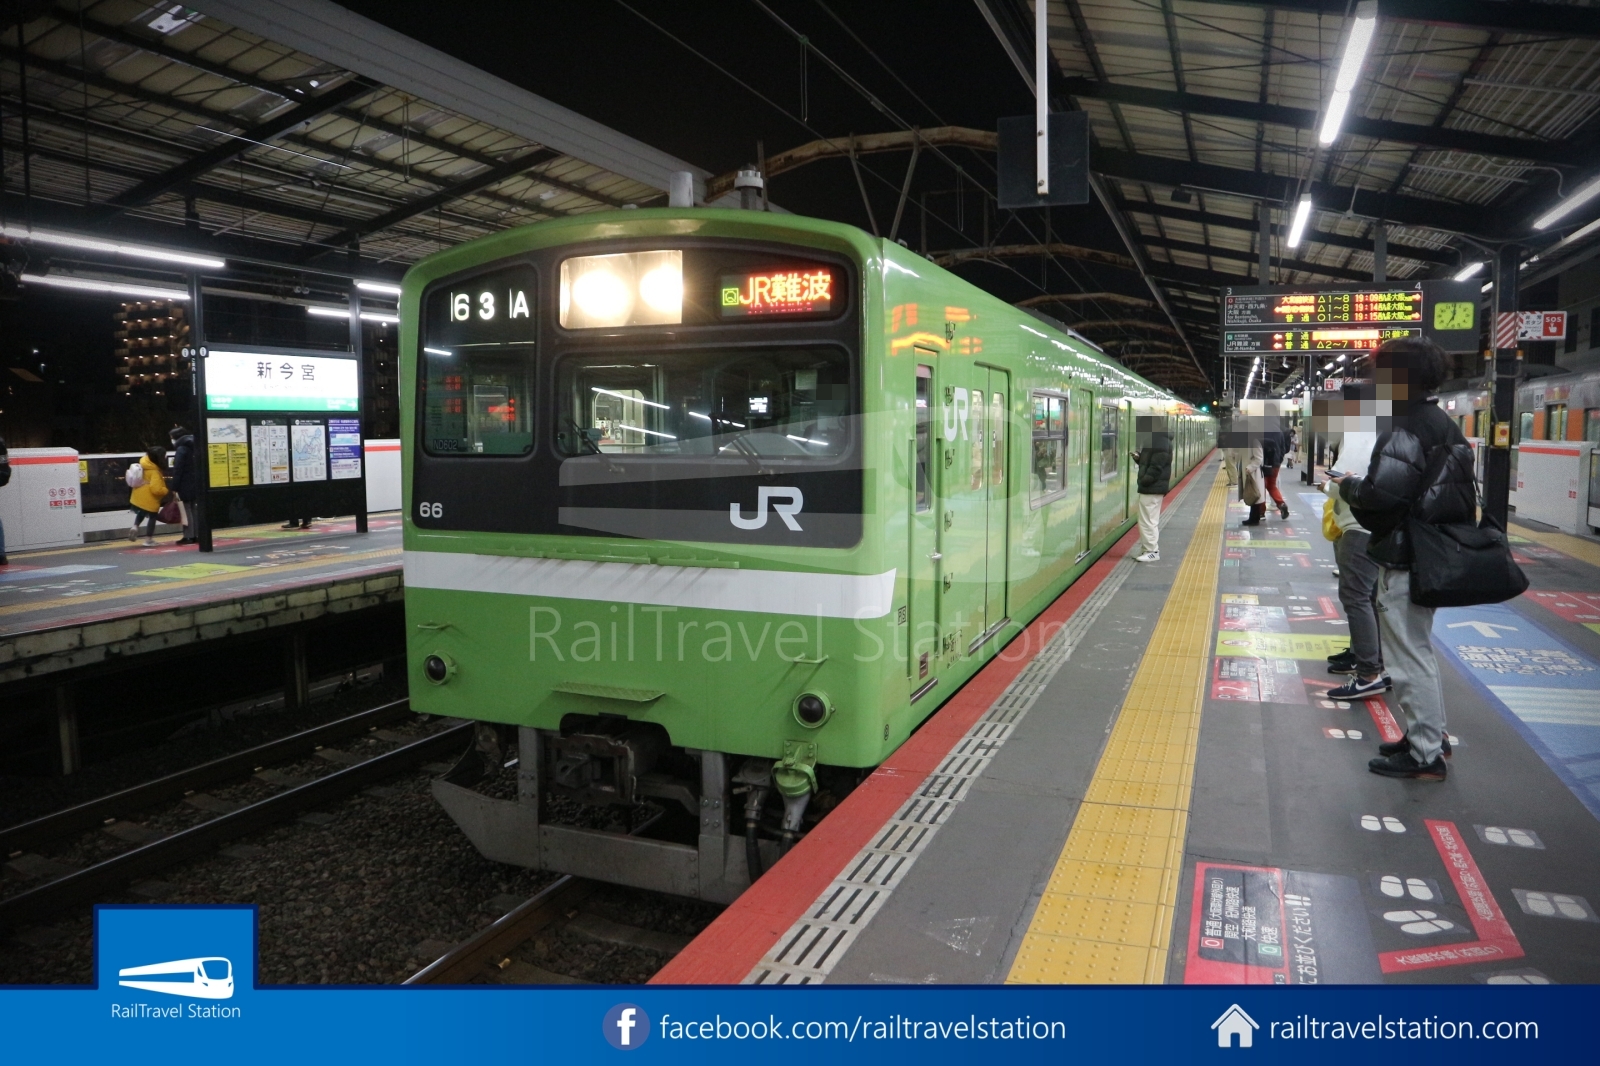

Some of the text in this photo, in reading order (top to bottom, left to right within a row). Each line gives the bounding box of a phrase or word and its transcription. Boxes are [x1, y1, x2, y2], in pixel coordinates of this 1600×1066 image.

[740, 272, 831, 304] JR難波
[1355, 293, 1378, 302] 19:09
[1355, 303, 1378, 311] 19:14
[1354, 340, 1376, 348] 19:16
[257, 361, 315, 381] 新今宮
[943, 386, 968, 442] JR
[419, 502, 443, 518] 66
[730, 486, 803, 532] JR
[1261, 926, 1279, 943] 快速
